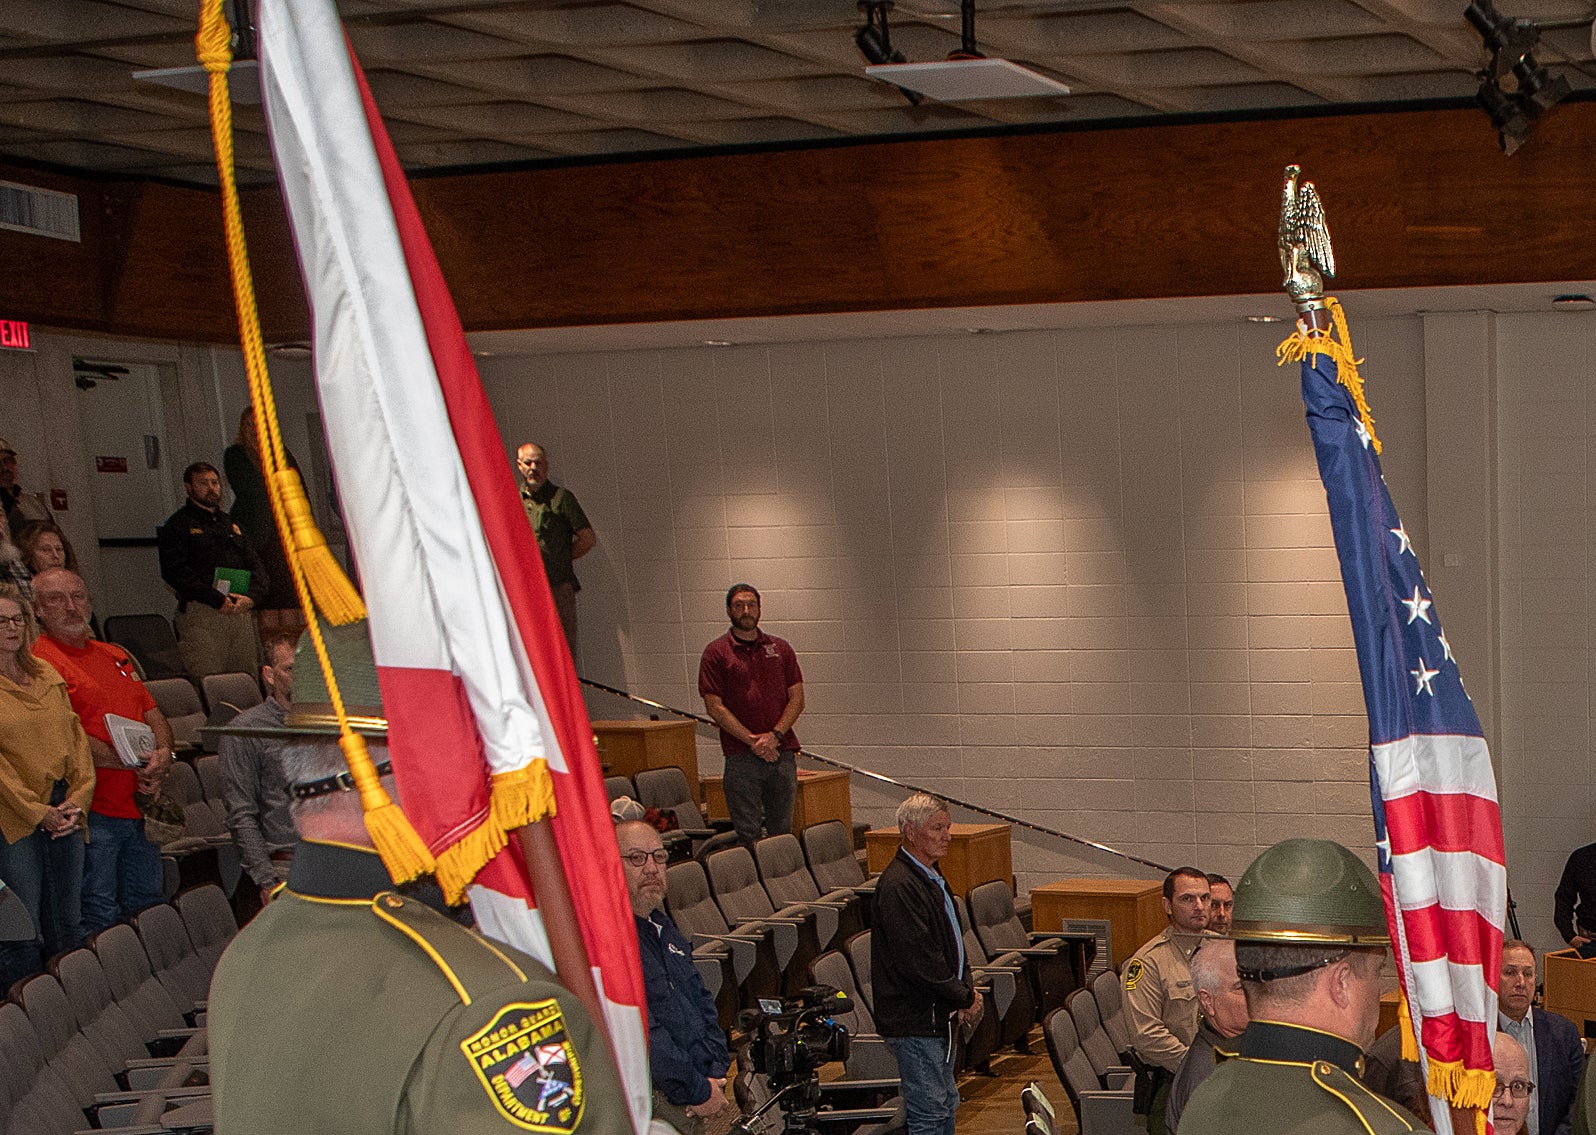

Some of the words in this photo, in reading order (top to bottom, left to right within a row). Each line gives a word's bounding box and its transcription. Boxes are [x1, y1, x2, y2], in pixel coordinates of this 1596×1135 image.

[0, 319, 31, 348] EXIT
[470, 1022, 519, 1053] HONOR
[480, 1021, 564, 1070] ALABAMA
[491, 1073, 550, 1125] DEPARTMENT
